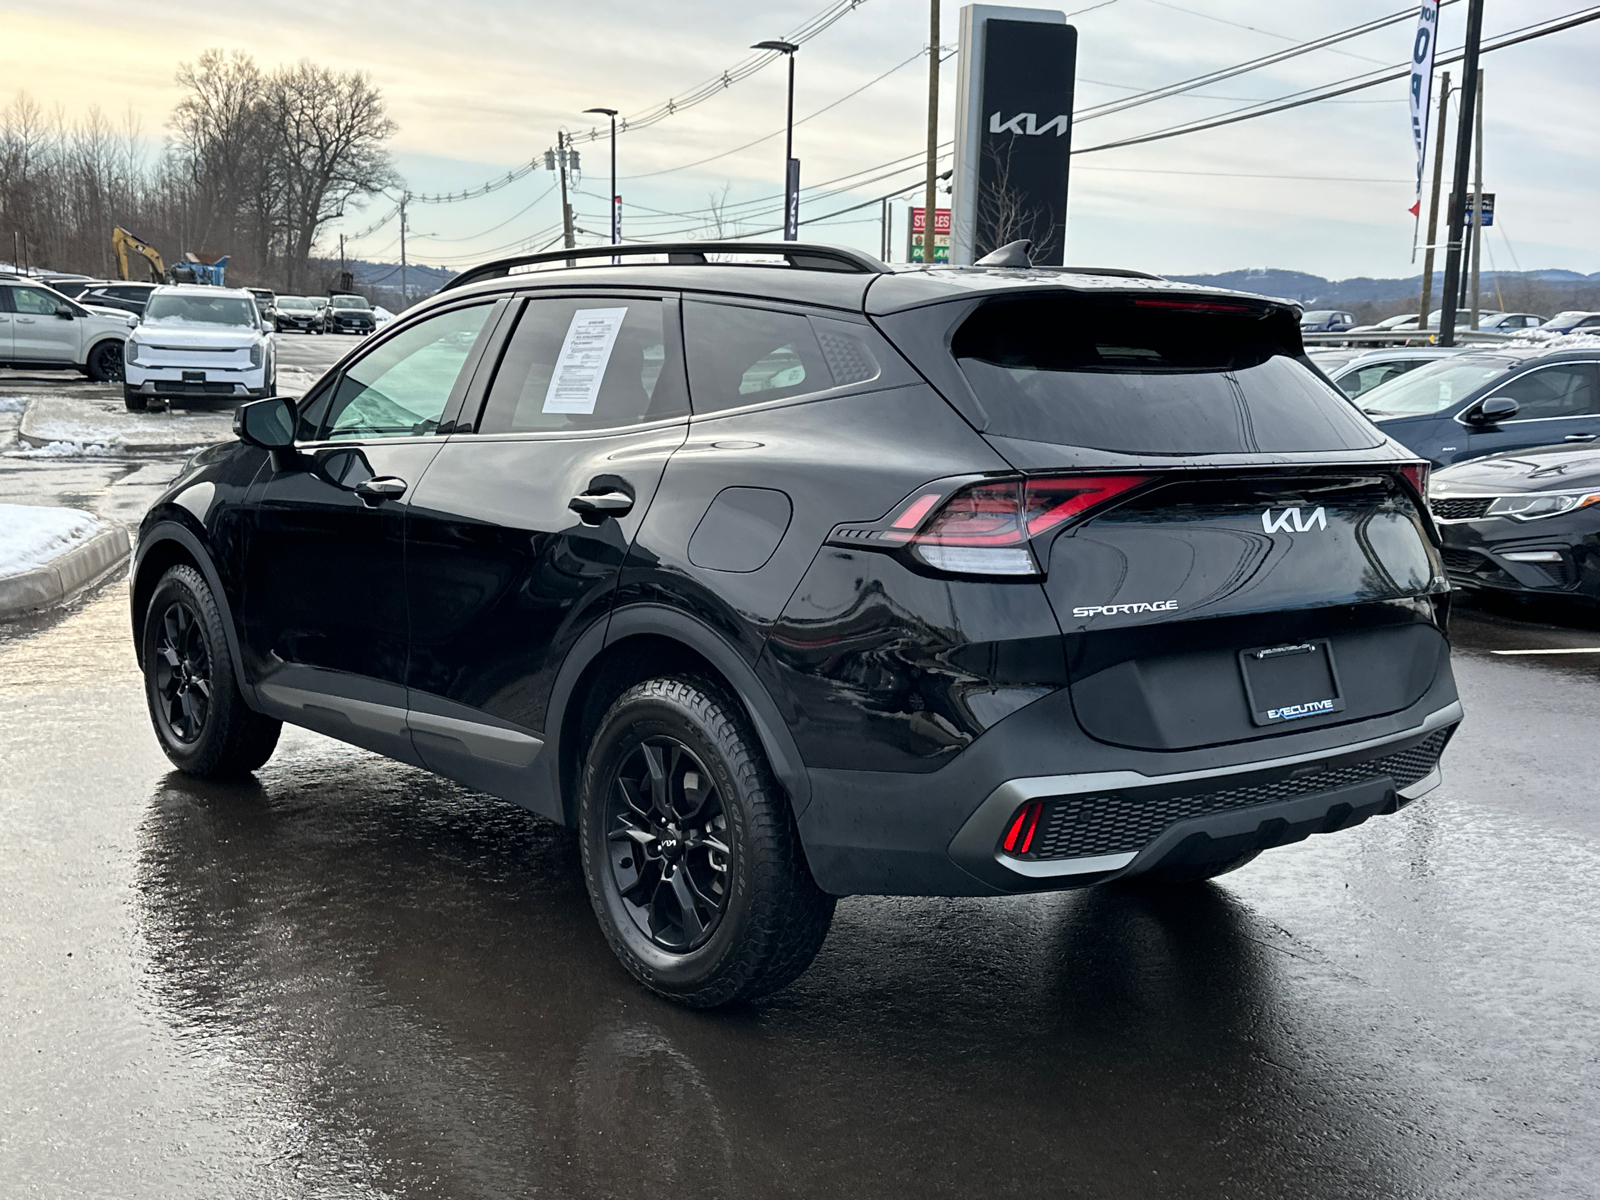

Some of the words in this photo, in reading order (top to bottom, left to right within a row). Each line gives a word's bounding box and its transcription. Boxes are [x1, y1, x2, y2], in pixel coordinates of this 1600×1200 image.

[989, 111, 1068, 137] KIA
[913, 214, 950, 228] STLES
[1261, 506, 1328, 534] KIA
[1072, 599, 1179, 618] SPORTAGE
[1267, 699, 1334, 719] EXECUTIVE
